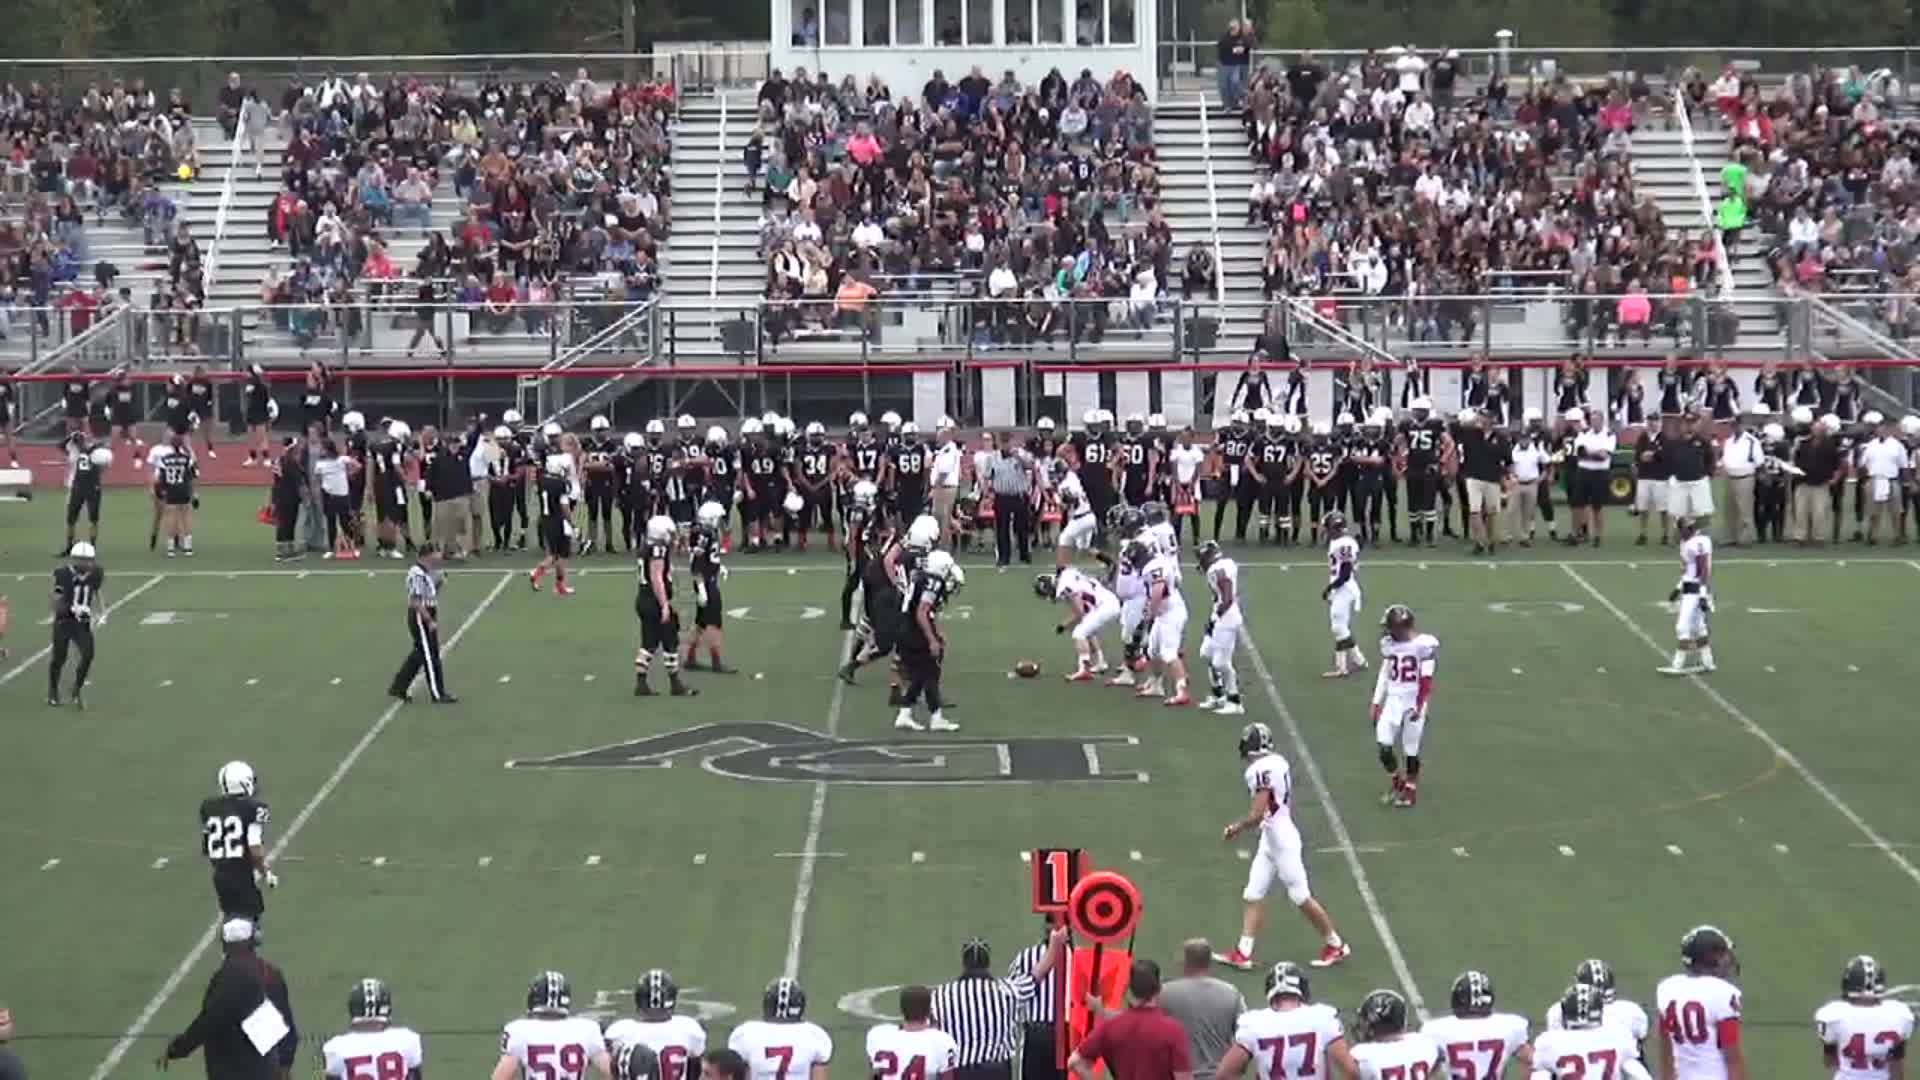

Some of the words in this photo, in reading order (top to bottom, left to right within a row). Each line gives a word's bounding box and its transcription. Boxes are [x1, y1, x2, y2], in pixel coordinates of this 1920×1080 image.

[1263, 445, 1286, 464] 67
[1409, 429, 1433, 450] 75
[751, 456, 775, 475] 49
[803, 454, 827, 475] 34
[857, 450, 877, 470] 17
[899, 453, 921, 473] 68
[1388, 654, 1418, 683] 32
[206, 815, 245, 859] 22
[1045, 850, 1069, 903] 1
[1663, 999, 1710, 1045] 40
[526, 1042, 588, 1080] 59
[764, 1045, 795, 1080] 7
[873, 1050, 927, 1080] 24
[1256, 1031, 1318, 1080] 77
[1446, 1038, 1505, 1080] 57
